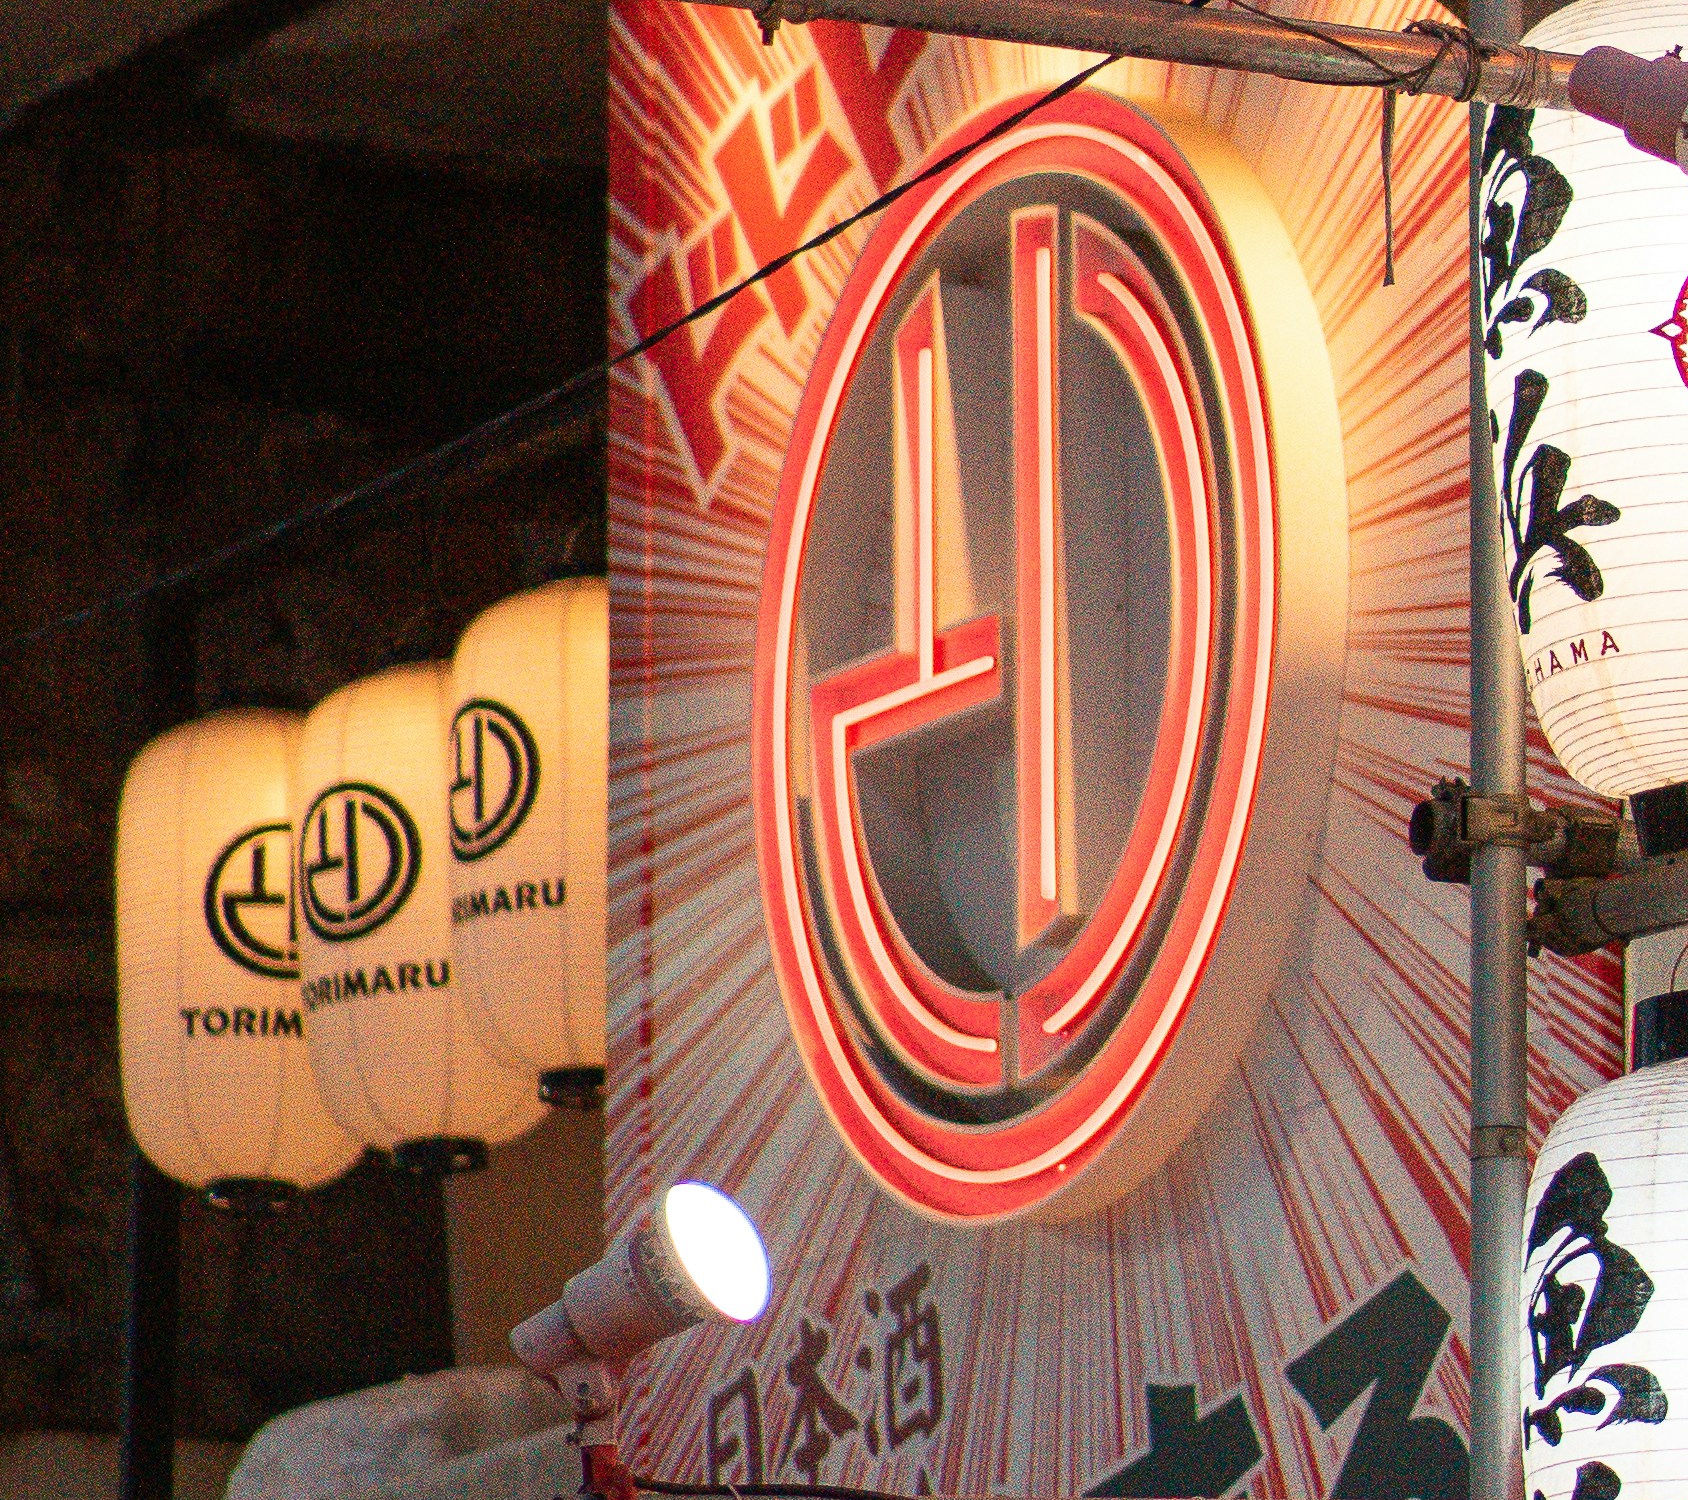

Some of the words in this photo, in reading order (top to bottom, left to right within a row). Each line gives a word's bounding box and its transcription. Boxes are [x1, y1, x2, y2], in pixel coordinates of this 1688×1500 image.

[1526, 630, 1620, 692] HAMA
[708, 1262, 943, 1486] 日本酒
